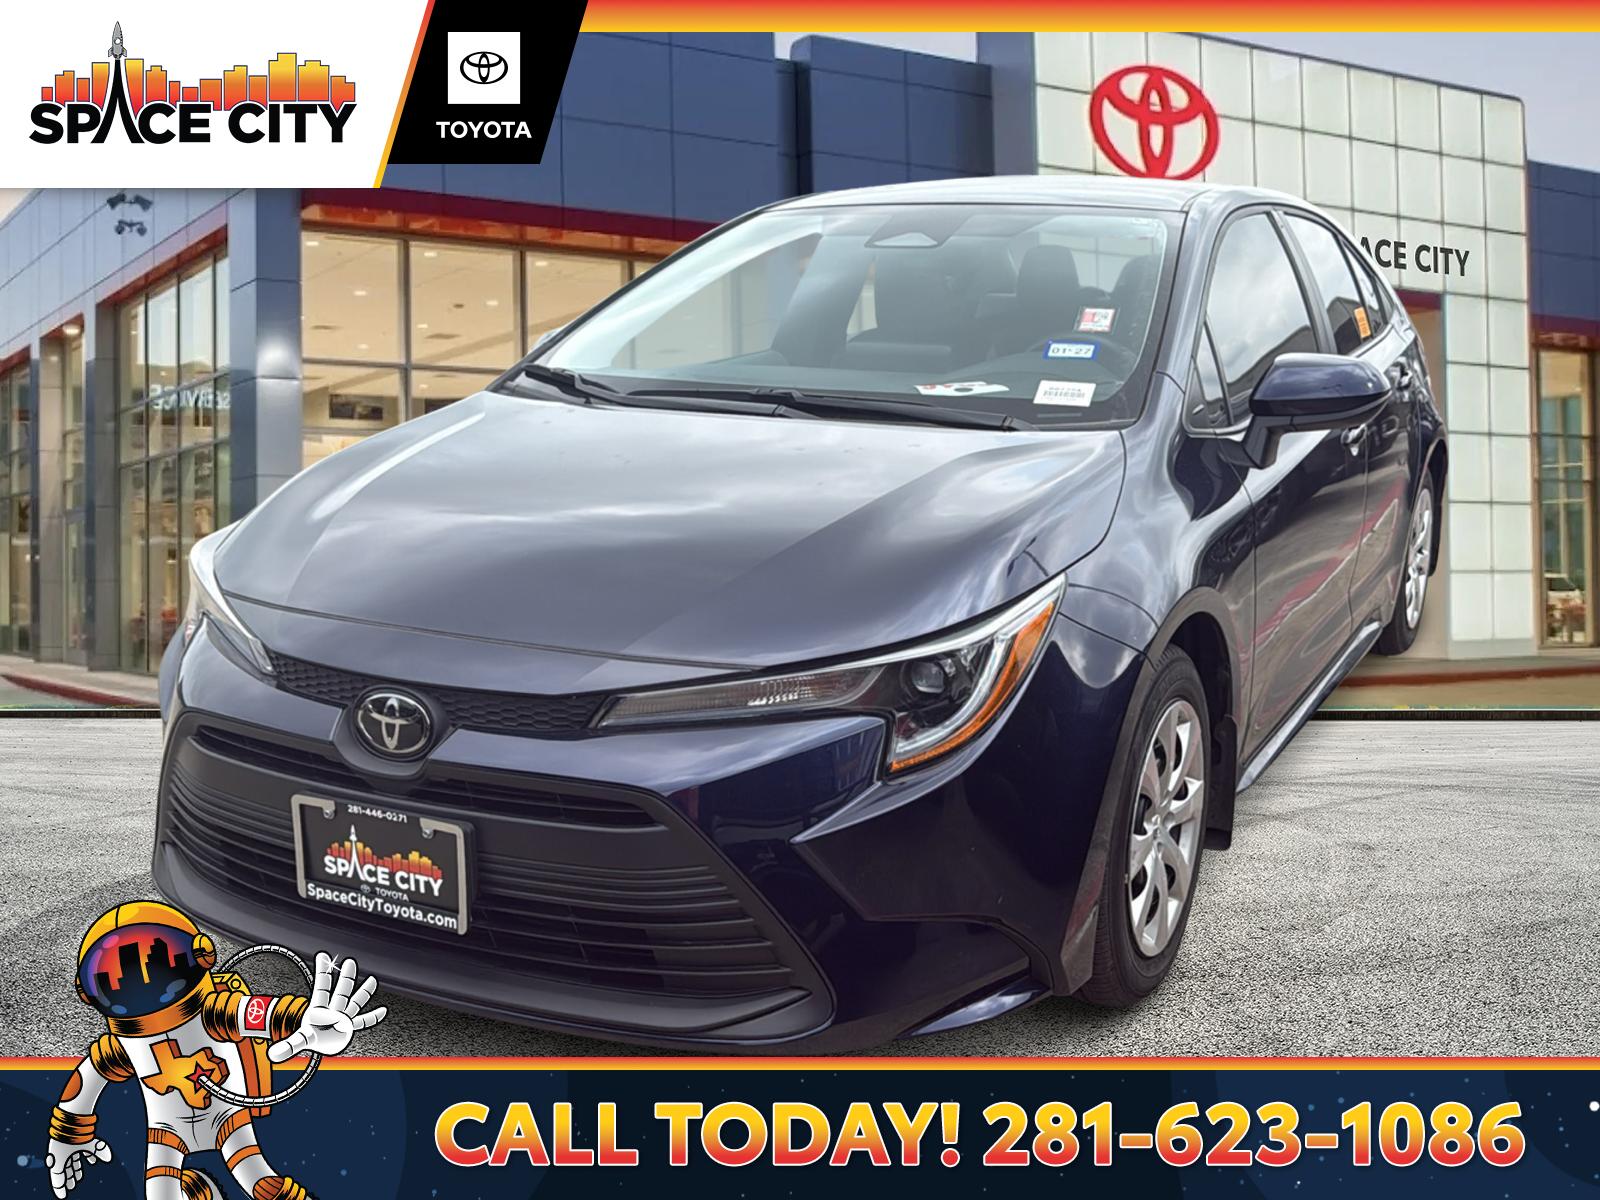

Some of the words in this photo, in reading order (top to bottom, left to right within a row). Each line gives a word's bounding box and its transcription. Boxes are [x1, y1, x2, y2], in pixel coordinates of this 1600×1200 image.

[1414, 244, 1470, 277] CITY
[347, 804, 408, 824] 281-446-0271
[323, 841, 391, 887] SPACE
[395, 870, 443, 897] CITY
[306, 882, 458, 930] SpaceCityToyota.com
[375, 886, 410, 902] TOYOTA
